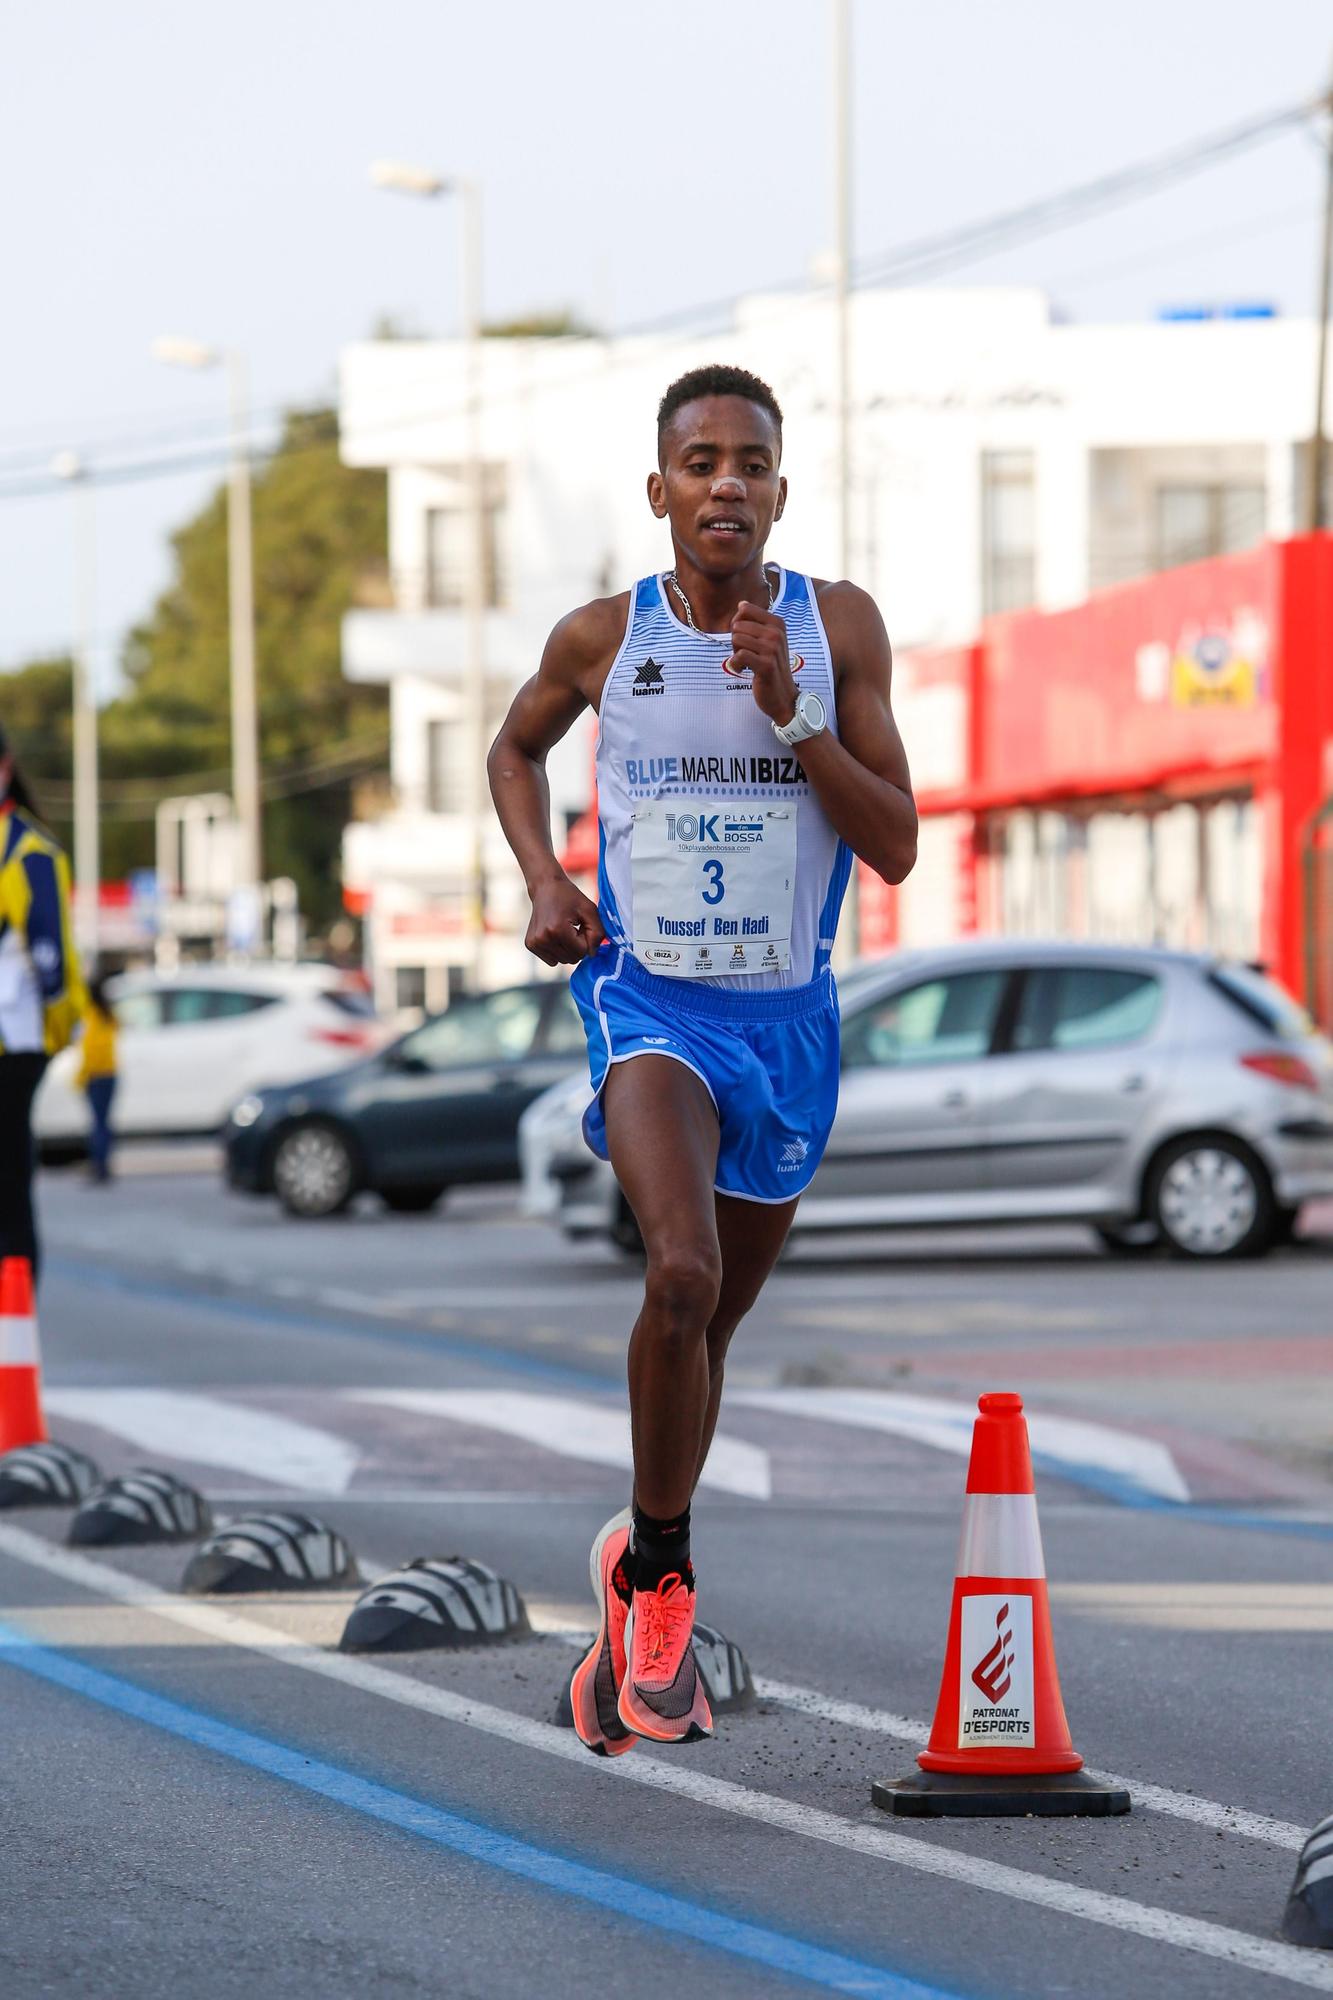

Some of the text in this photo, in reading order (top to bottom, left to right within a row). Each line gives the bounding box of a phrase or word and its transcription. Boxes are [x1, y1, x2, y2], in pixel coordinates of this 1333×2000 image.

[632, 686, 664, 696] luanvi
[626, 757, 808, 784] BLUE MARLIN IBIZA
[665, 814, 719, 841] 10K
[725, 833, 763, 842] BOSSA
[679, 843, 750, 852] 10kplayadenbossa.com
[702, 860, 724, 904] 3
[657, 916, 768, 936] Youssef Ben Hadi
[973, 1708, 1019, 1717] PATRONAT
[964, 1721, 1029, 1733] D'ESPORTS
